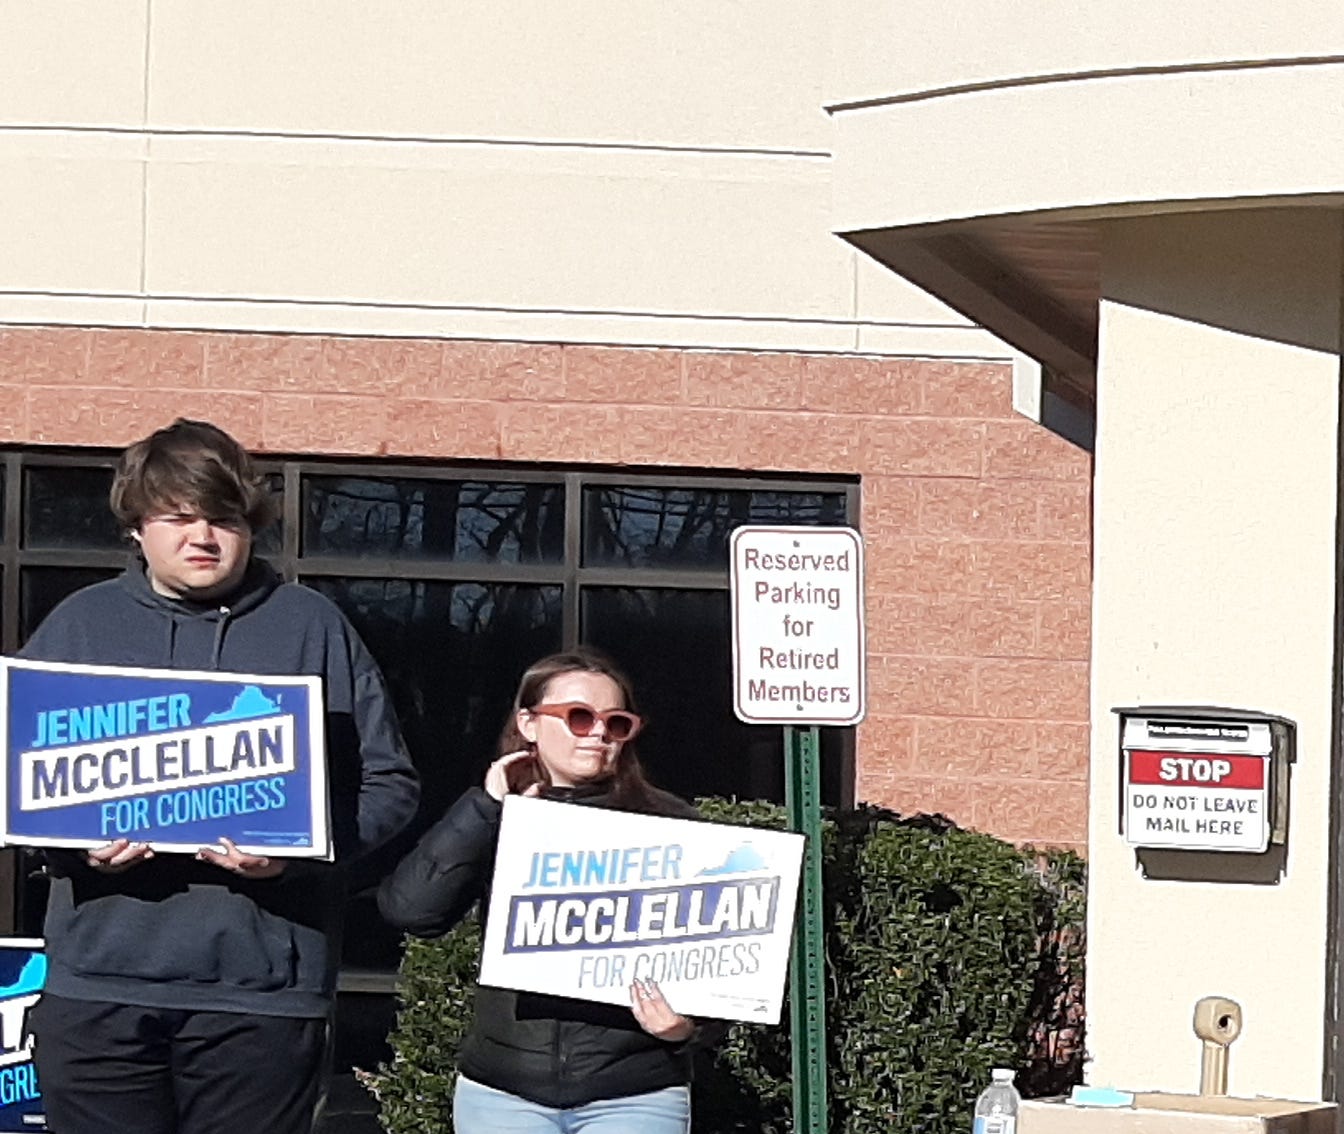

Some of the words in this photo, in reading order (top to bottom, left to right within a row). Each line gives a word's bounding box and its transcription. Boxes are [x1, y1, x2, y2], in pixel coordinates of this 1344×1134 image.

[745, 548, 850, 571] Reserved
[755, 581, 841, 611] Parking
[782, 614, 814, 637] for
[759, 646, 839, 670] Retired
[748, 678, 851, 703] Members
[31, 693, 192, 748] JENNIFER
[31, 725, 285, 801] MCCLELLAN
[1158, 758, 1231, 782] STOP
[101, 799, 150, 836] FOR
[156, 777, 287, 827] CONGRESS
[1133, 794, 1157, 809] DO
[1163, 796, 1197, 811] NOT
[1204, 797, 1258, 814] LEAVE
[1146, 817, 1190, 833] MAIL
[1196, 819, 1244, 835] HERE
[522, 844, 684, 889] JENNIFER
[512, 882, 774, 948] MCCLELLAN
[578, 955, 627, 989] FOR
[632, 943, 761, 984] CONGRESS
